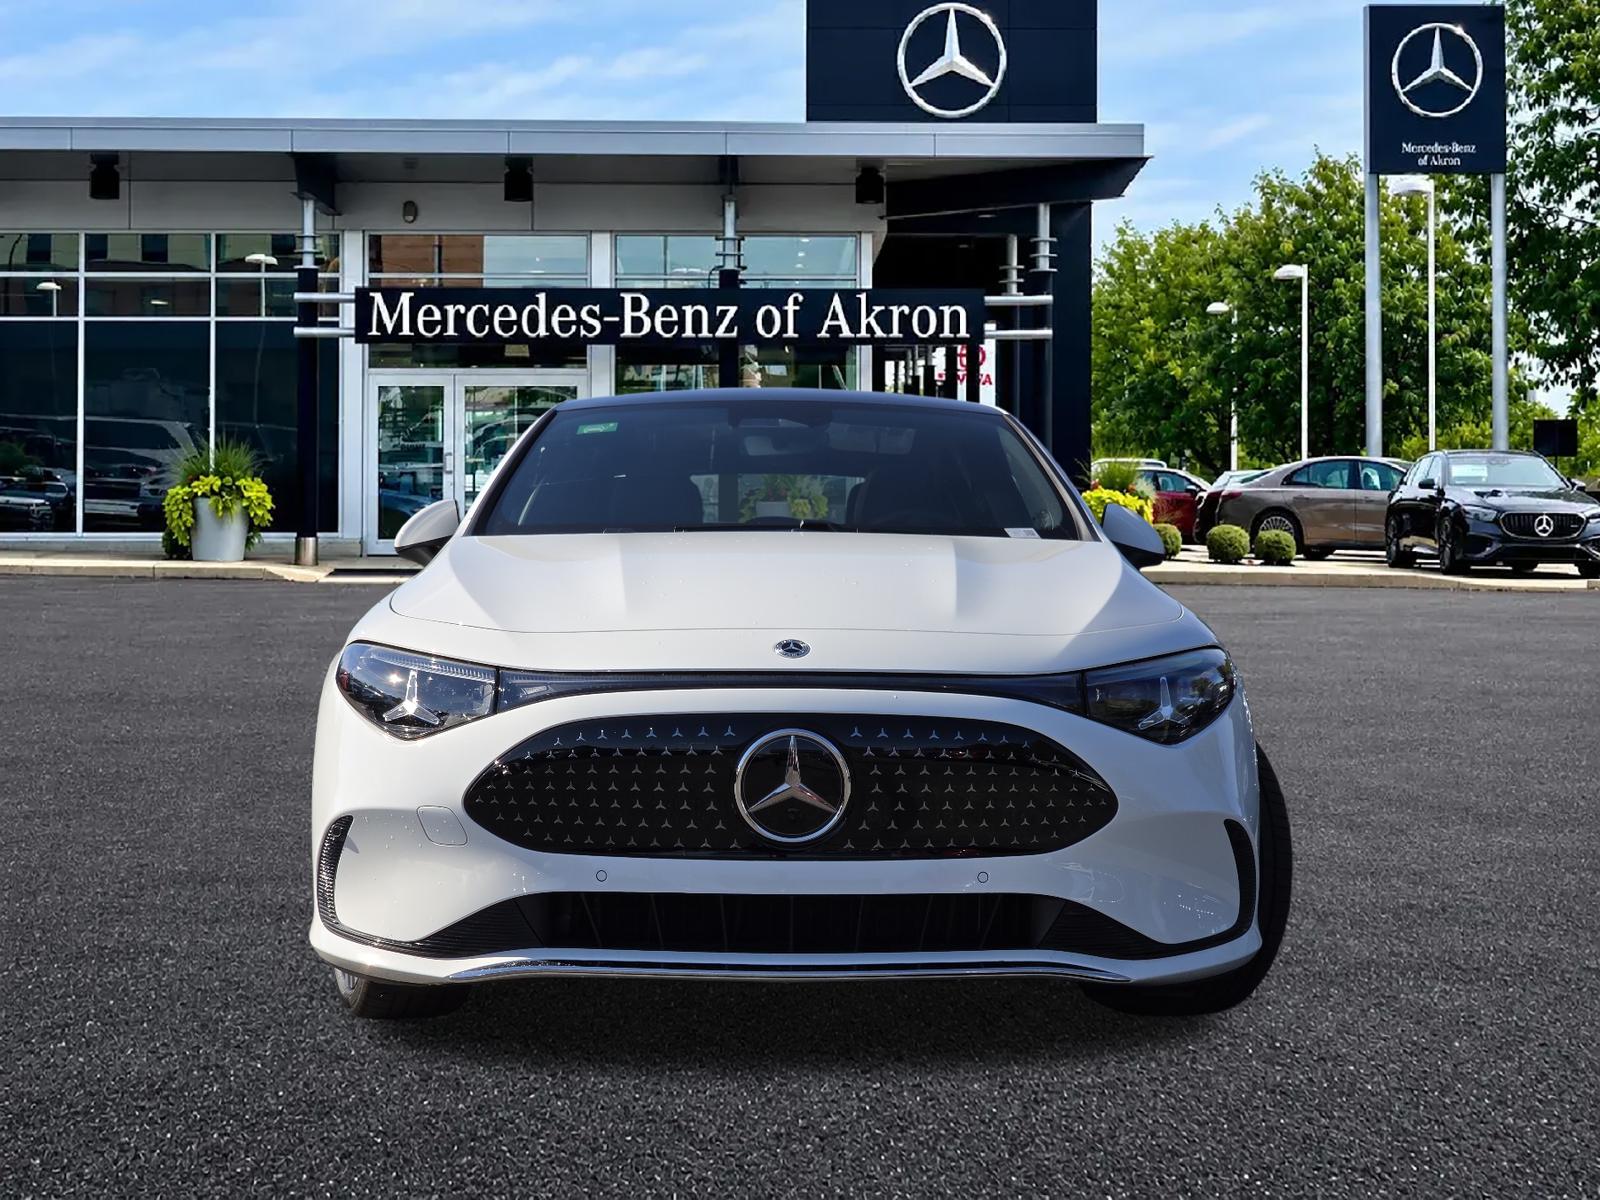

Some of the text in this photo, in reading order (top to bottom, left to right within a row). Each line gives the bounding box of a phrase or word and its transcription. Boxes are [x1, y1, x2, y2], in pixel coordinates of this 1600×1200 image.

[1401, 142, 1477, 154] Mercedes-Benz
[1418, 154, 1461, 166] of Akron
[367, 291, 971, 338] Mercedes-Benz of Akron
